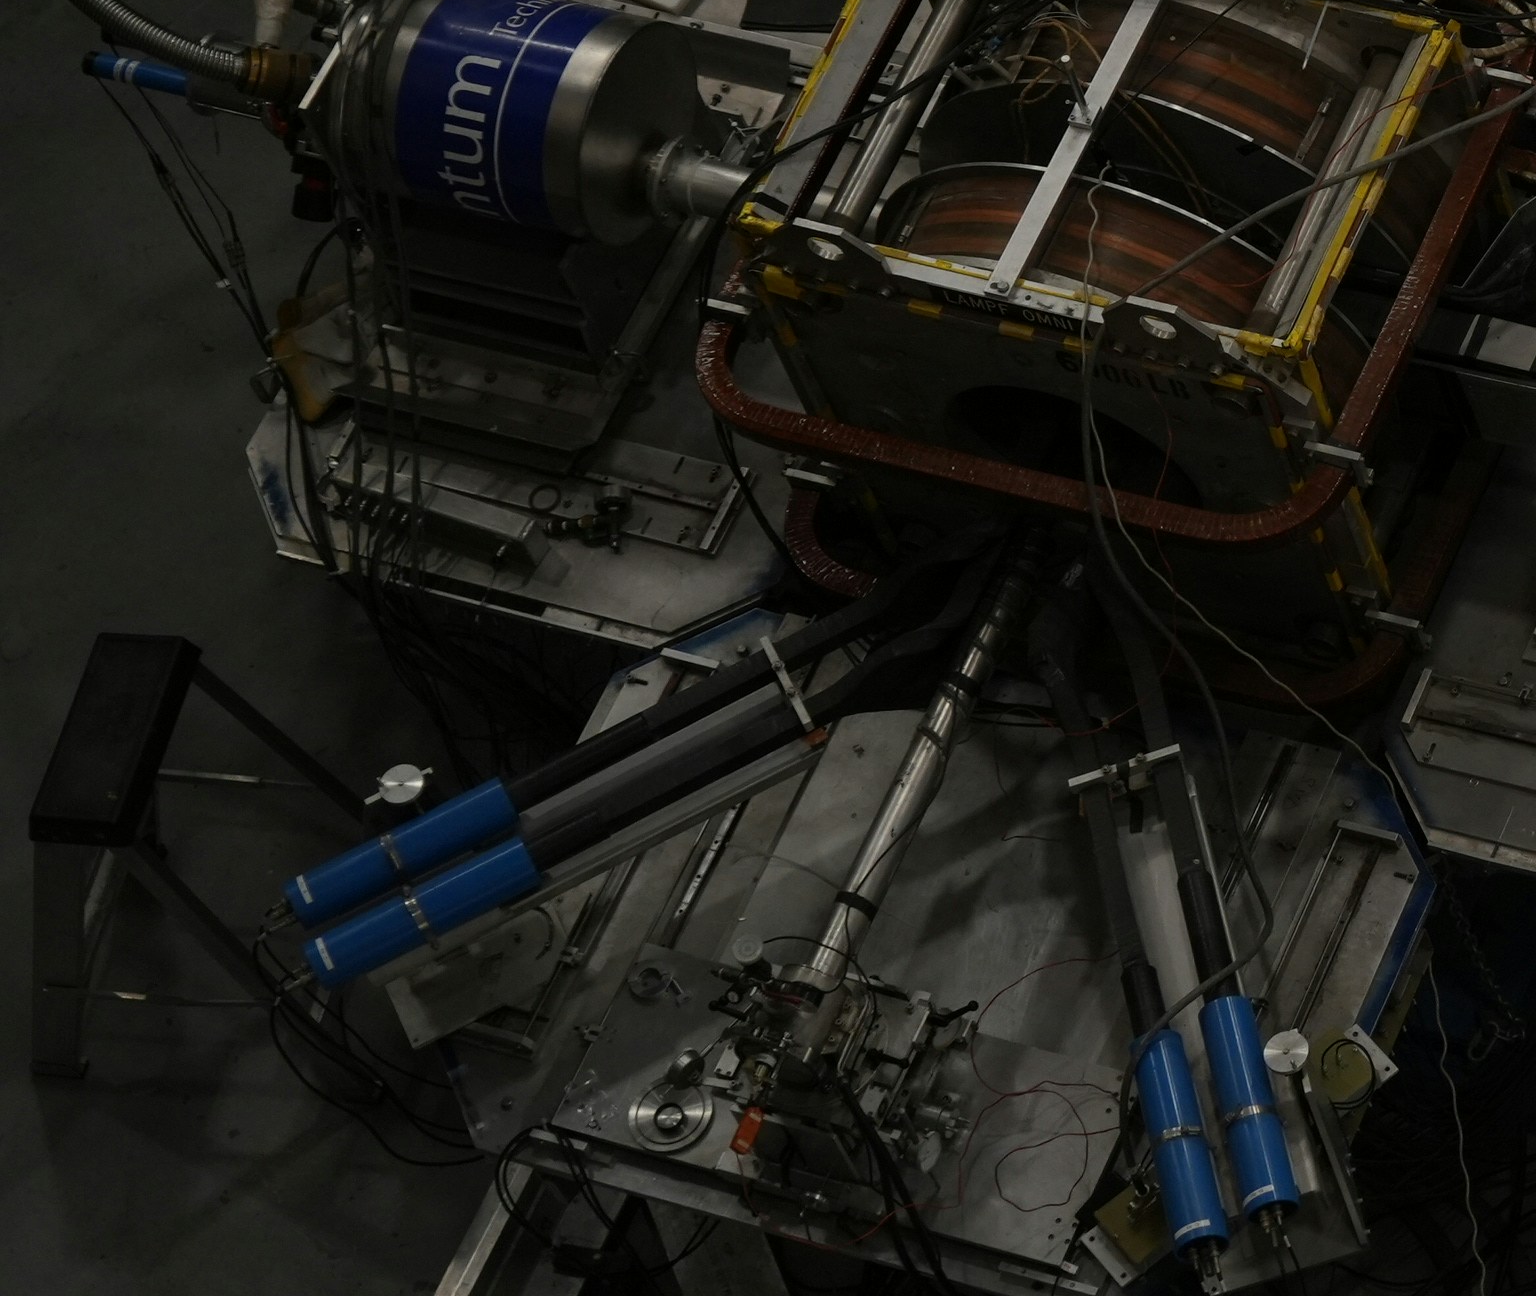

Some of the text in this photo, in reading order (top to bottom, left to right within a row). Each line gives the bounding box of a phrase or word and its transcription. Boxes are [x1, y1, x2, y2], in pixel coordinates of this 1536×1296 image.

[943, 289, 1075, 333] LAMPF OMNI
[1055, 350, 1190, 400] 600LB
